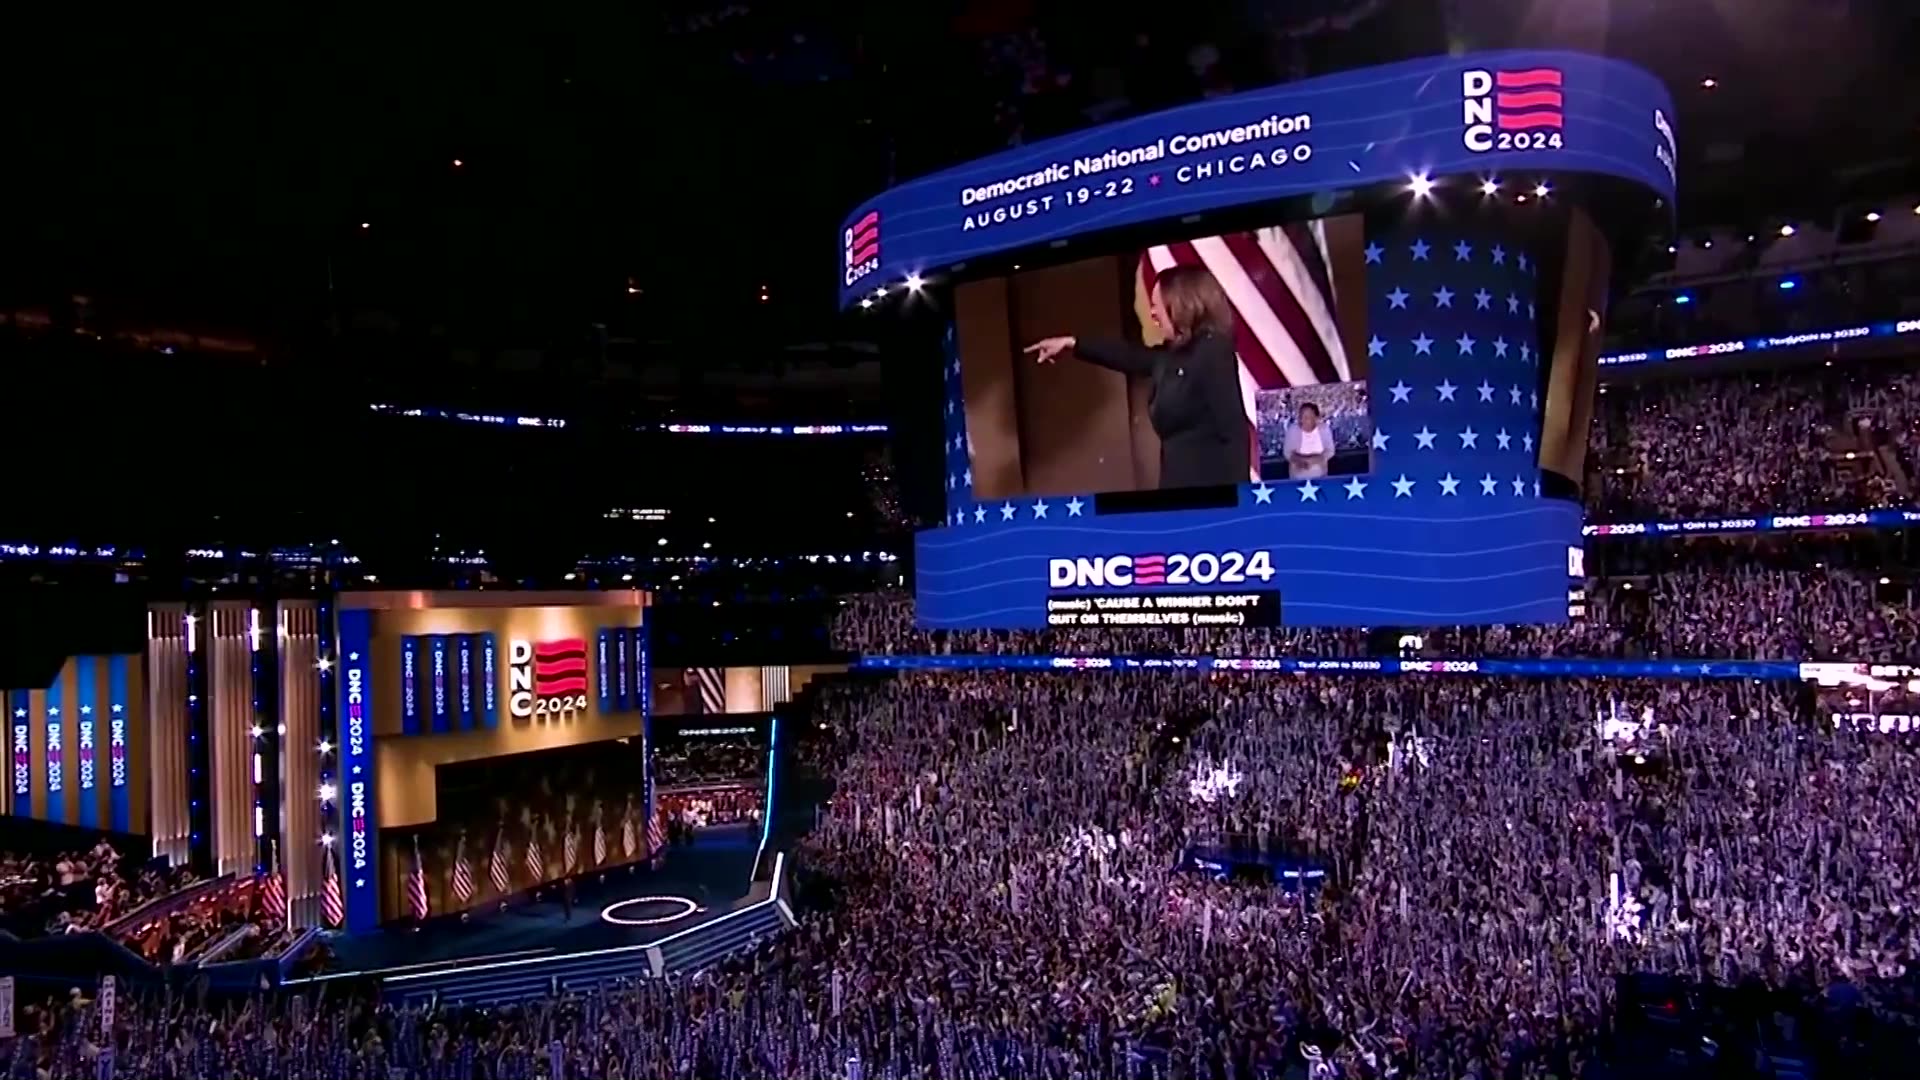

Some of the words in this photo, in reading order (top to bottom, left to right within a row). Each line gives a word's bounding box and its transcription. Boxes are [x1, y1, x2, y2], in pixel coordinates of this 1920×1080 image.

[1497, 132, 1563, 150] 2024
[962, 163, 1070, 206] Democratic
[1073, 138, 1165, 177] National
[1169, 113, 1311, 155] Convention
[963, 195, 1054, 232] AUGUST
[1065, 177, 1134, 206] 19-22
[1176, 144, 1312, 183] CHICAGO
[1047, 598, 1092, 612] (music)
[1093, 596, 1141, 610] 'CAUSE
[1142, 596, 1154, 609] A
[1155, 595, 1213, 608] WINNER
[1214, 594, 1261, 607] DON'T
[1047, 612, 1079, 626] QUIT
[1080, 612, 1100, 625] ON
[1101, 612, 1190, 625] THEMSELVES
[1192, 611, 1245, 626] (music)
[536, 694, 587, 715] 2024
